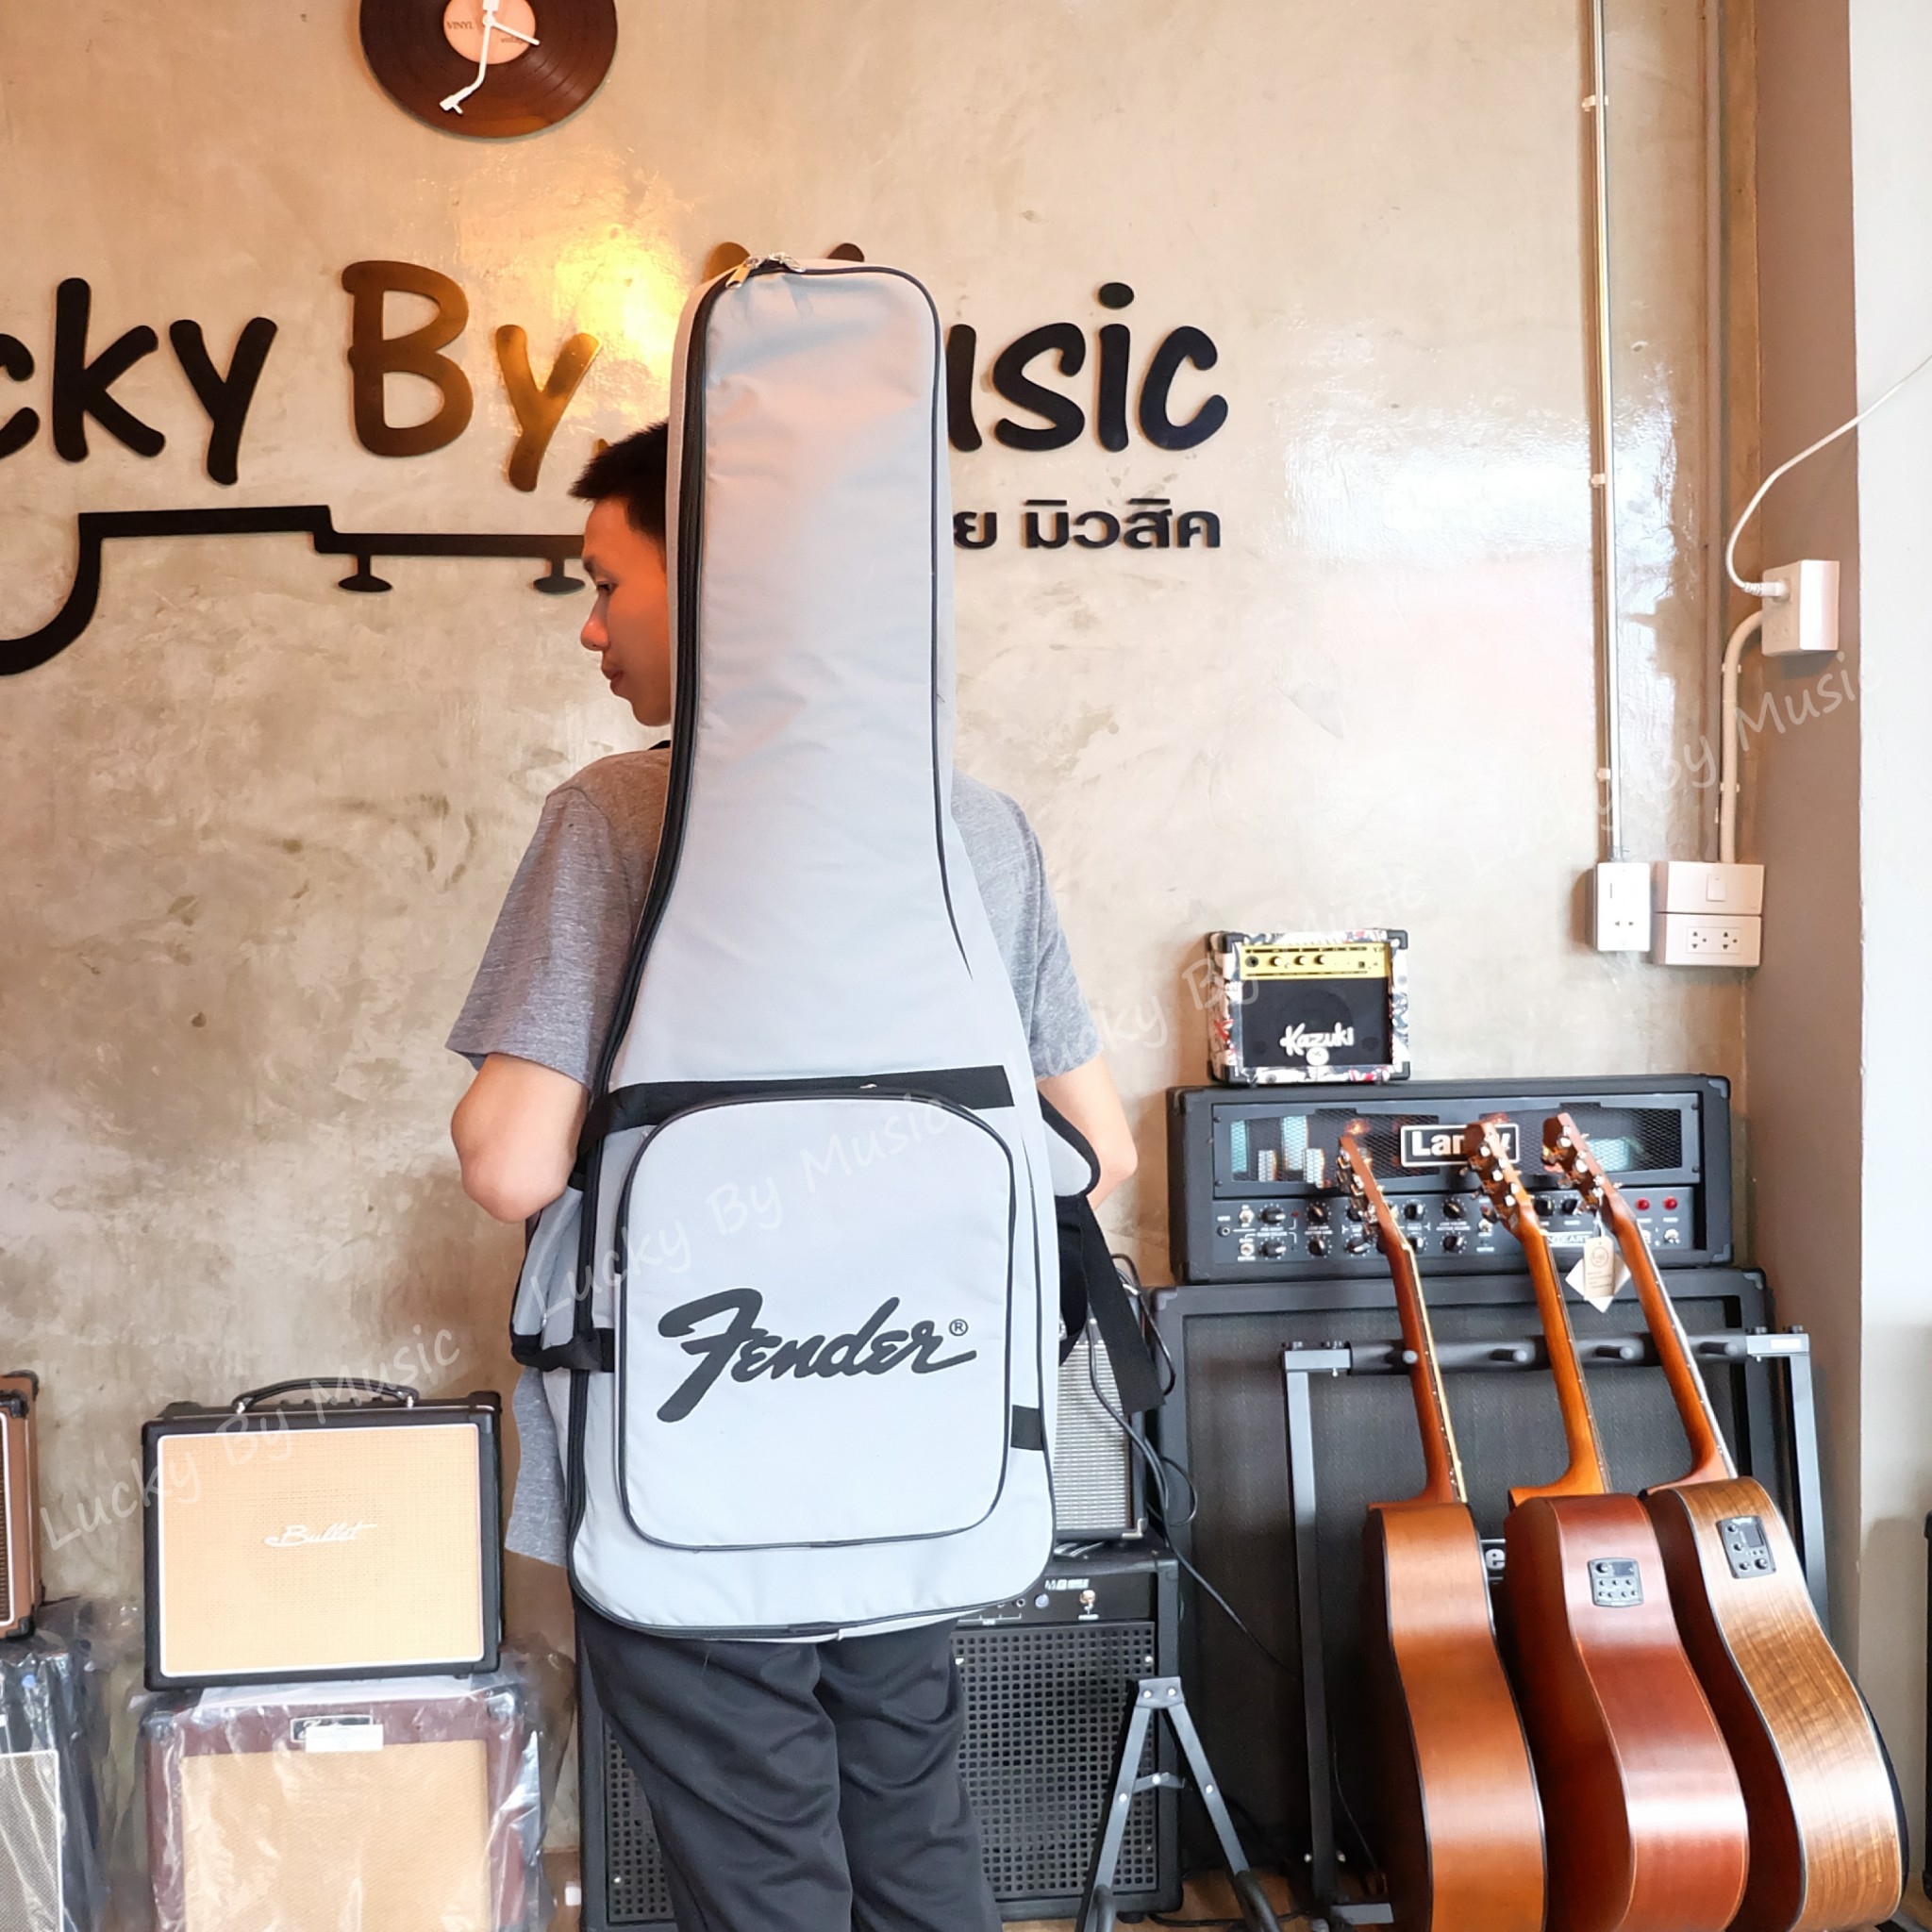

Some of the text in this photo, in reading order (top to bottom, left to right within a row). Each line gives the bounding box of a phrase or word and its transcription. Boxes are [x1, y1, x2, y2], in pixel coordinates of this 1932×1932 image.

[446, 21, 475, 30] VINYL
[341, 259, 601, 492] By
[1023, 497, 1222, 549] มิวสิค
[1279, 1022, 1355, 1057] Kazuki
[264, 1522, 377, 1547] Bullet
